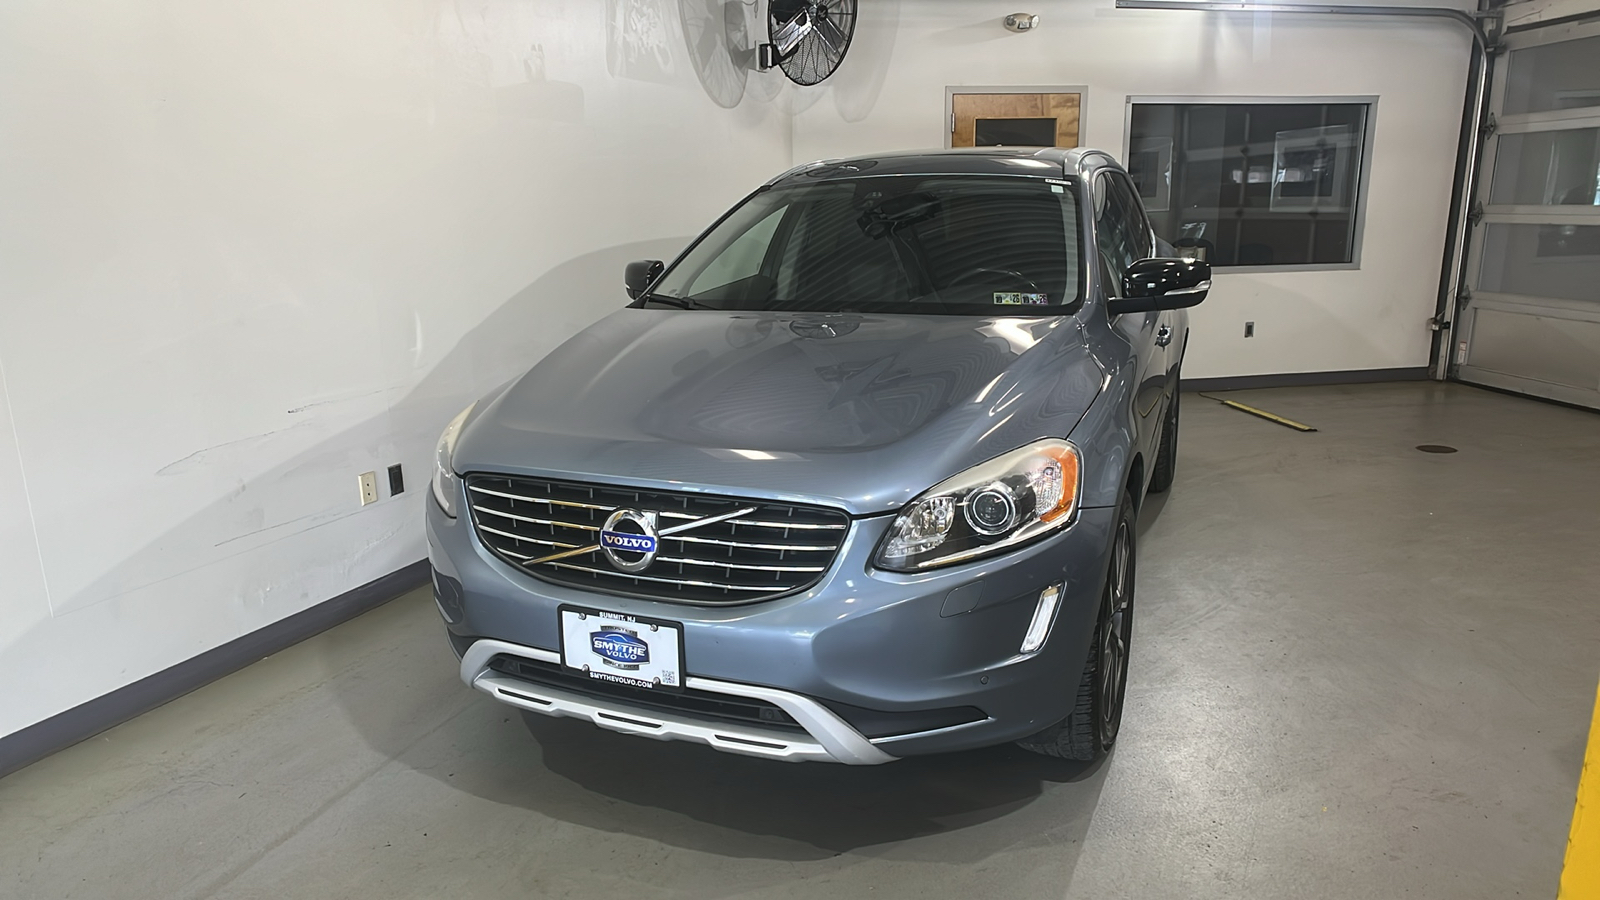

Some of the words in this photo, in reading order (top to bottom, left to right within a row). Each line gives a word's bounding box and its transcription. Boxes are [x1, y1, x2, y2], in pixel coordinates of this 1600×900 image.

[604, 535, 652, 548] VOLVO
[599, 611, 626, 621] SUMMIT,
[594, 640, 645, 656] SMYTHE
[606, 649, 637, 660] VOLVO
[589, 671, 653, 689] SMYTHEVOLVO.COM
